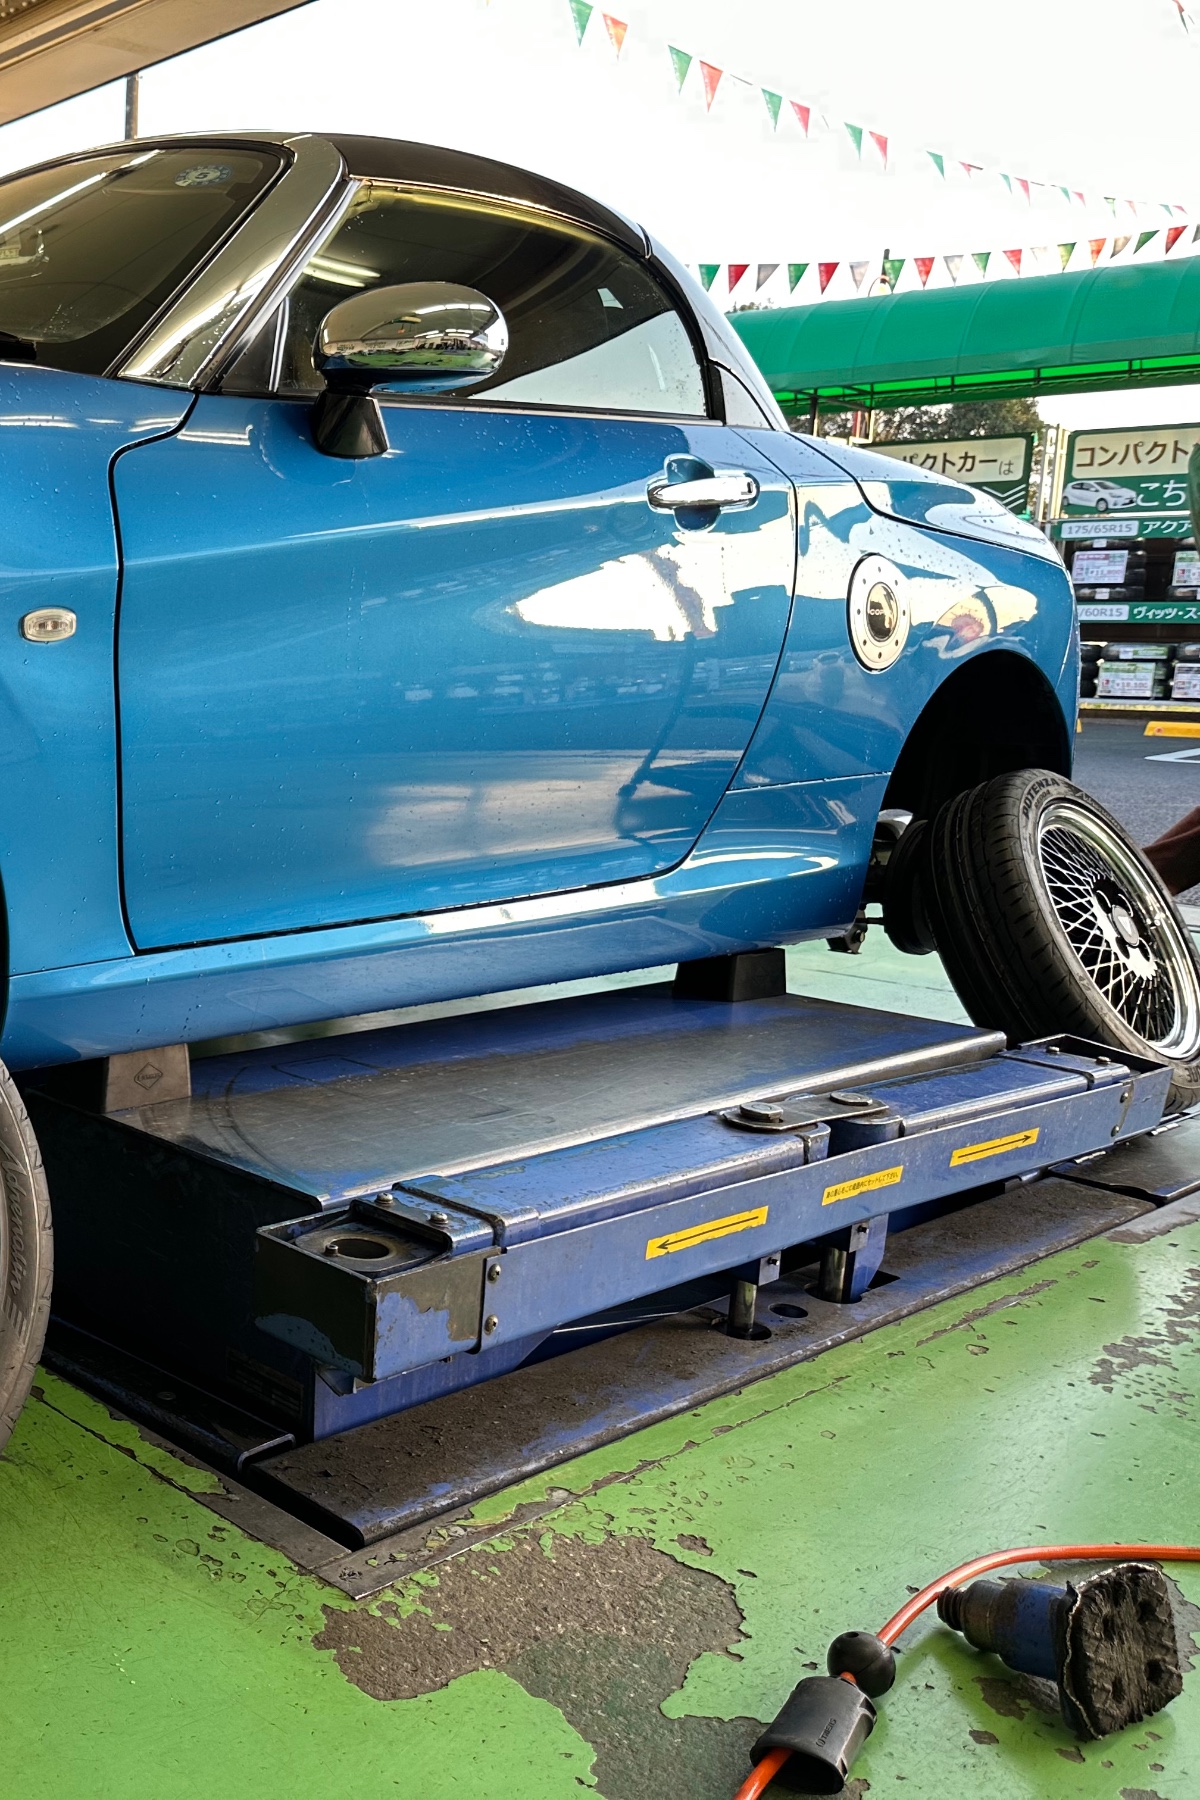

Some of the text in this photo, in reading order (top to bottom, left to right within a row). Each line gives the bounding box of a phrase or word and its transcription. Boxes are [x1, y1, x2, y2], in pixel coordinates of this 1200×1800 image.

[1076, 440, 1189, 467] コンパクト
[1137, 480, 1187, 506] こち
[1067, 523, 1133, 535] 175/65R15
[1078, 607, 1123, 618] /60R15
[1133, 606, 1200, 619] ヴィッツ・ス
[1022, 778, 1060, 820] POTENZA
